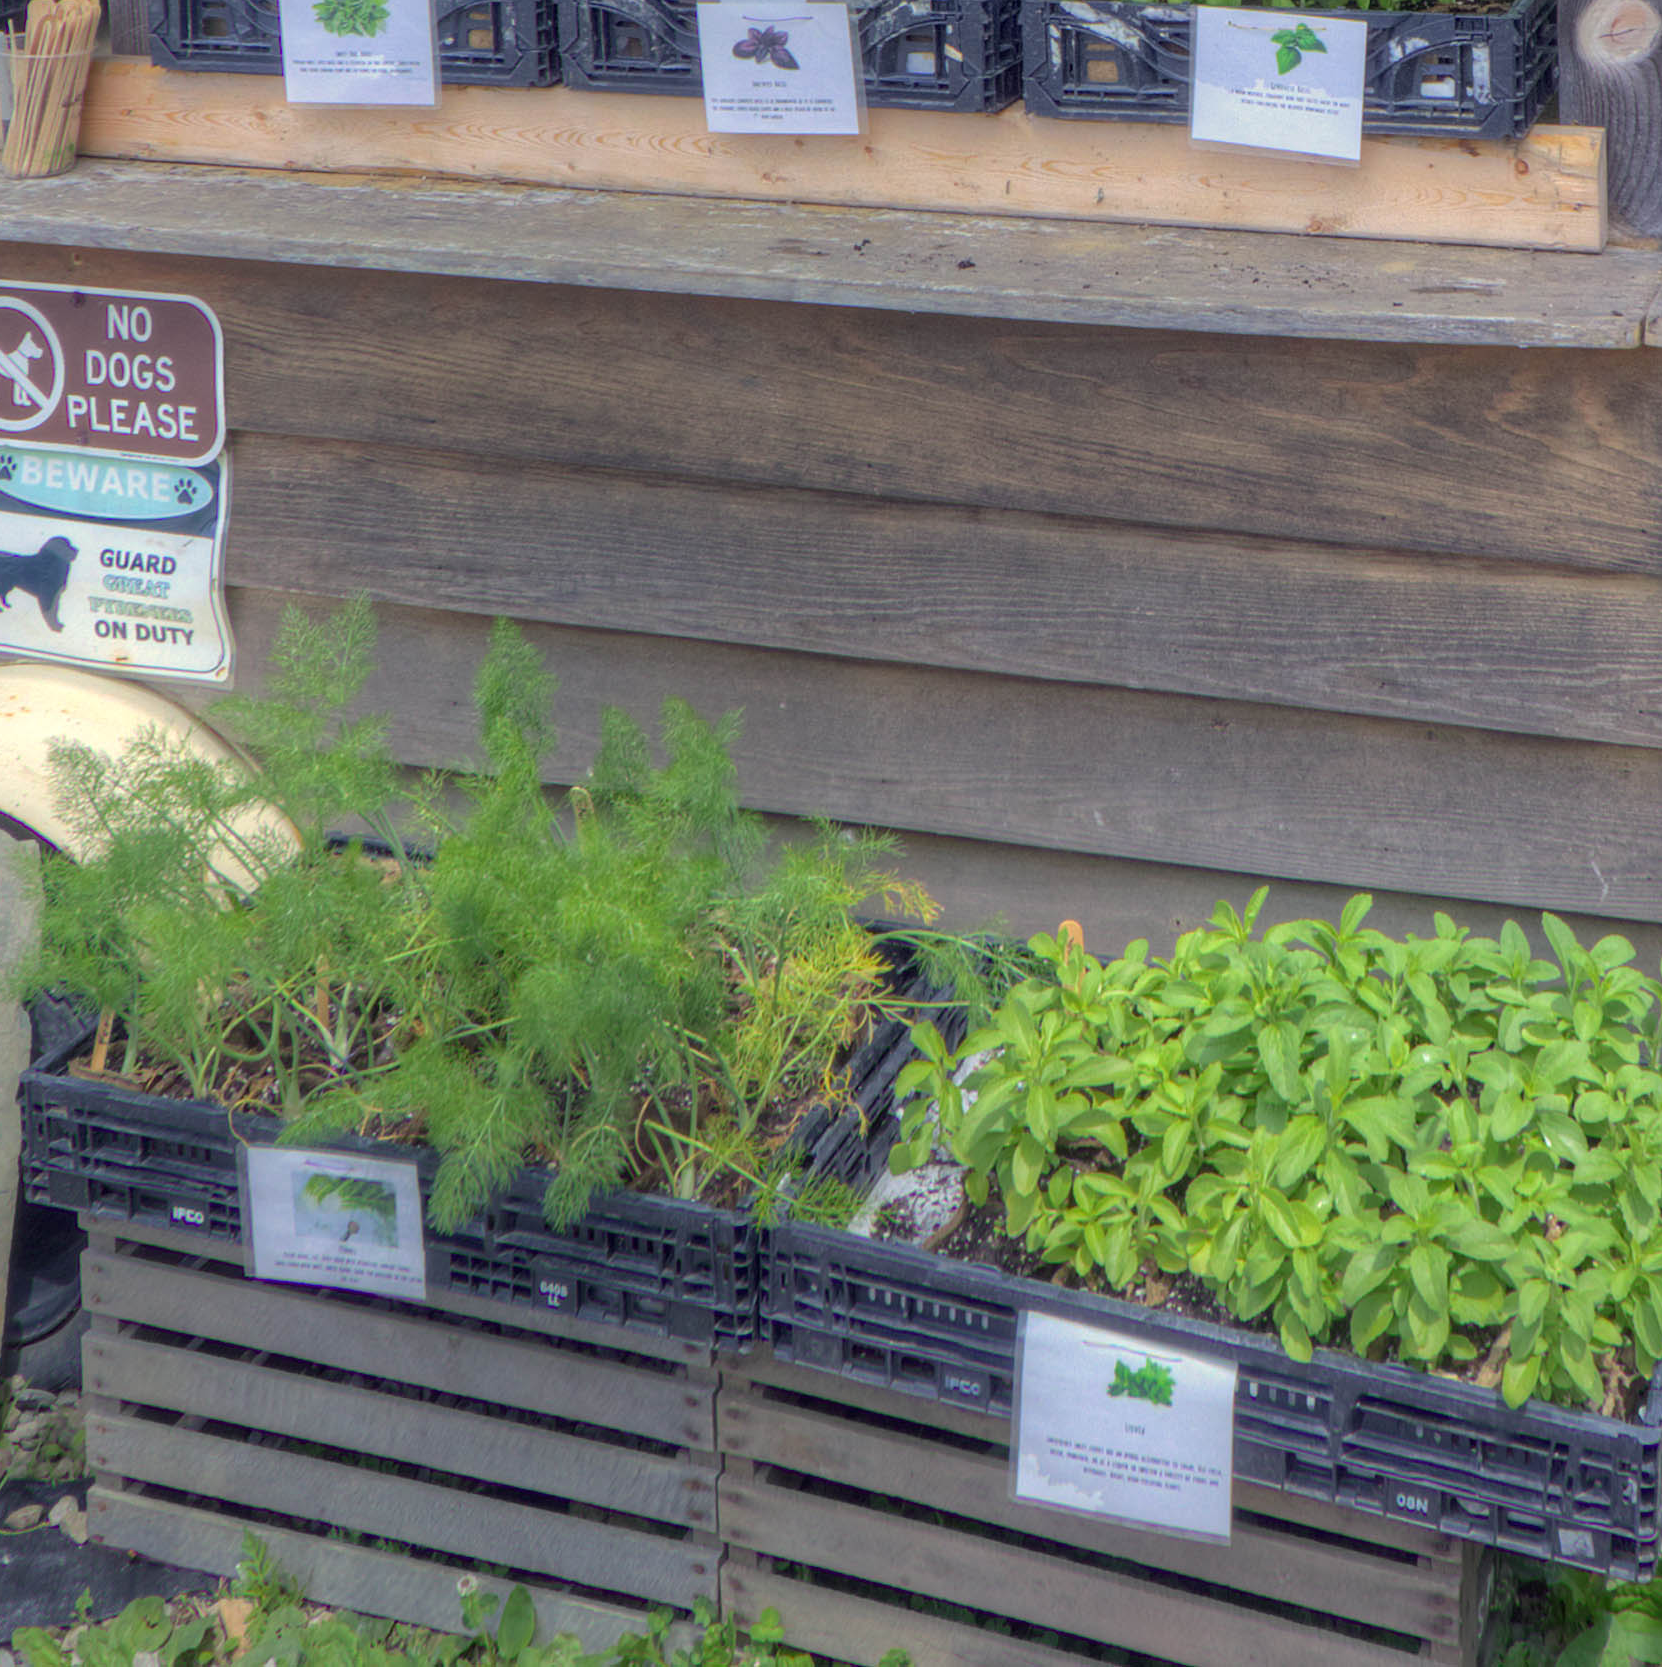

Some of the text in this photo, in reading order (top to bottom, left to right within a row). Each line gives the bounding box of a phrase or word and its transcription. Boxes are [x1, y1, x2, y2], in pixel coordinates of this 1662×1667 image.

[106, 303, 153, 343] NO
[85, 349, 177, 392] DOGS
[66, 394, 200, 442] PLEASE
[19, 454, 172, 503] BEWARE
[99, 548, 178, 575] GUARD
[94, 620, 195, 646] ON DUTY
